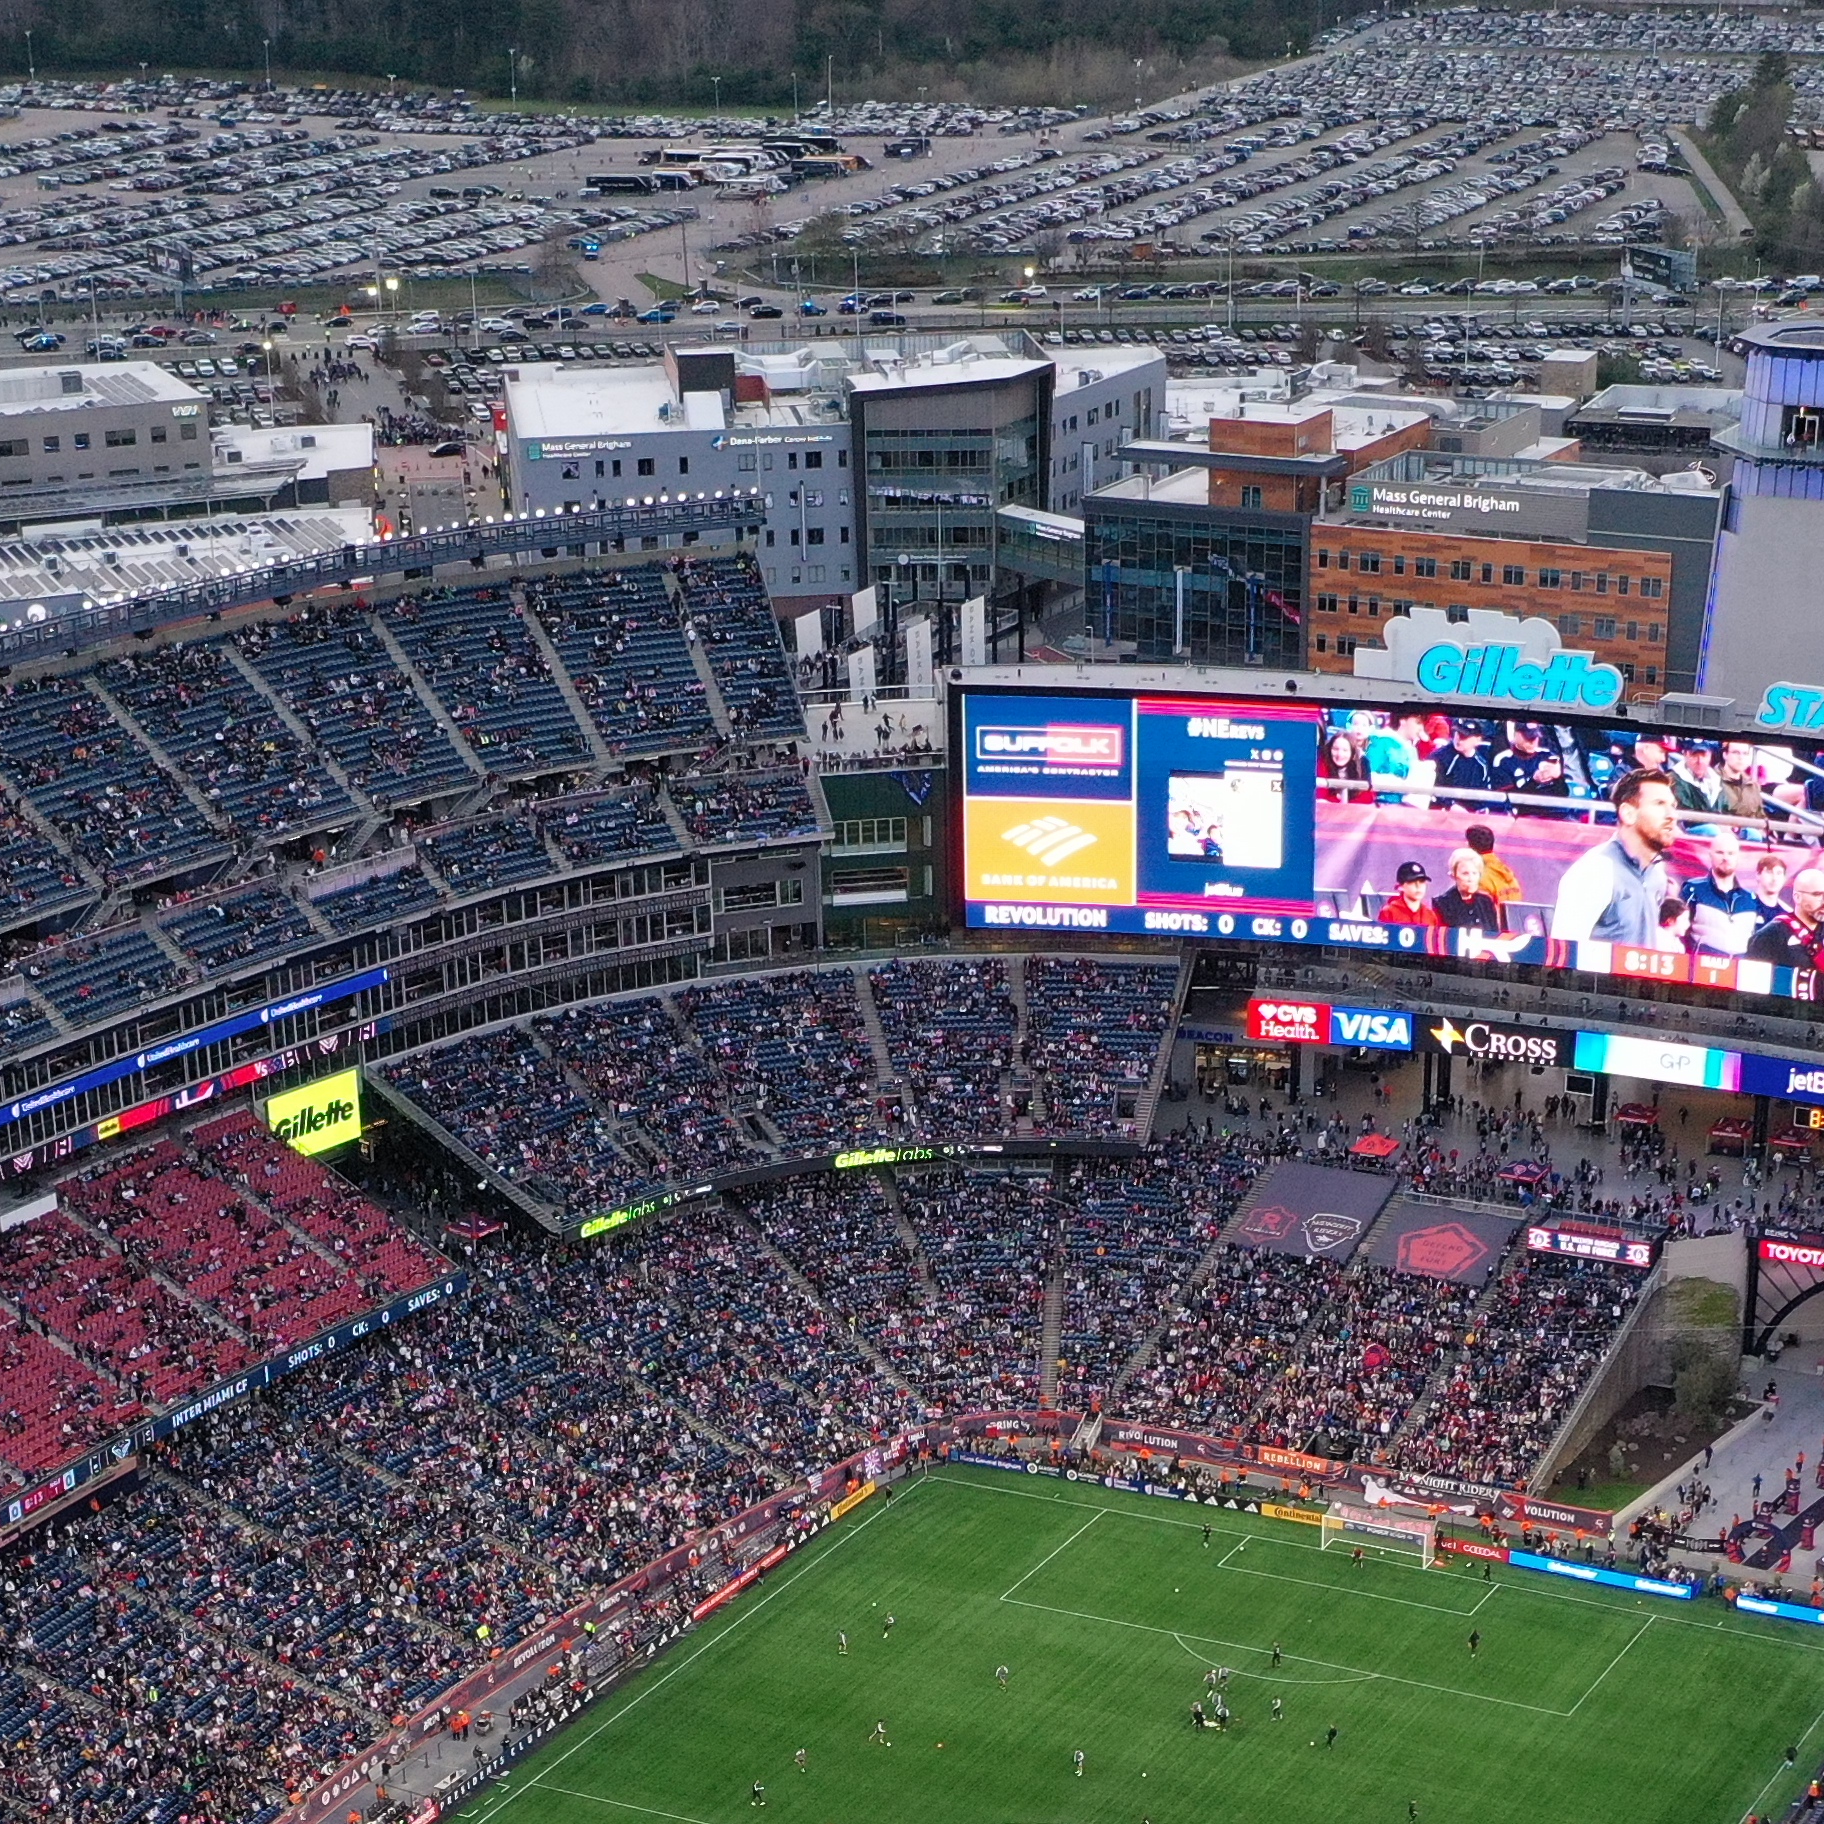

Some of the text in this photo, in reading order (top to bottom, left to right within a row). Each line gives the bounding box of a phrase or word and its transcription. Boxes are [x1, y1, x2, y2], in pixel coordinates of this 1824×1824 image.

[1372, 505, 1451, 519] Healthcare Center
[1373, 487, 1520, 513] Mass General Brigham
[1417, 643, 1619, 708] Gillette
[983, 735, 1110, 755] SUFFOLK
[981, 874, 1118, 890] BANK OF AMERICA
[985, 905, 1107, 927] REVOLUTION
[1144, 911, 1234, 934] SHOTS: 0
[1252, 917, 1308, 939] CK: 0
[1329, 922, 1415, 947] SAVES: 0
[1624, 950, 1674, 975] 8:13
[1277, 1005, 1316, 1023] CVS
[1334, 1013, 1409, 1045] VISA
[274, 1097, 355, 1144] Gillette
[407, 1282, 453, 1312] SAVES: 0
[352, 1311, 389, 1337] CK: 0
[288, 1336, 336, 1369] SHOTS: 0
[172, 1379, 248, 1428] INTER MIAMI CF
[1263, 1452, 1321, 1471] REBELLION
[1273, 1505, 1322, 1522] Continental
